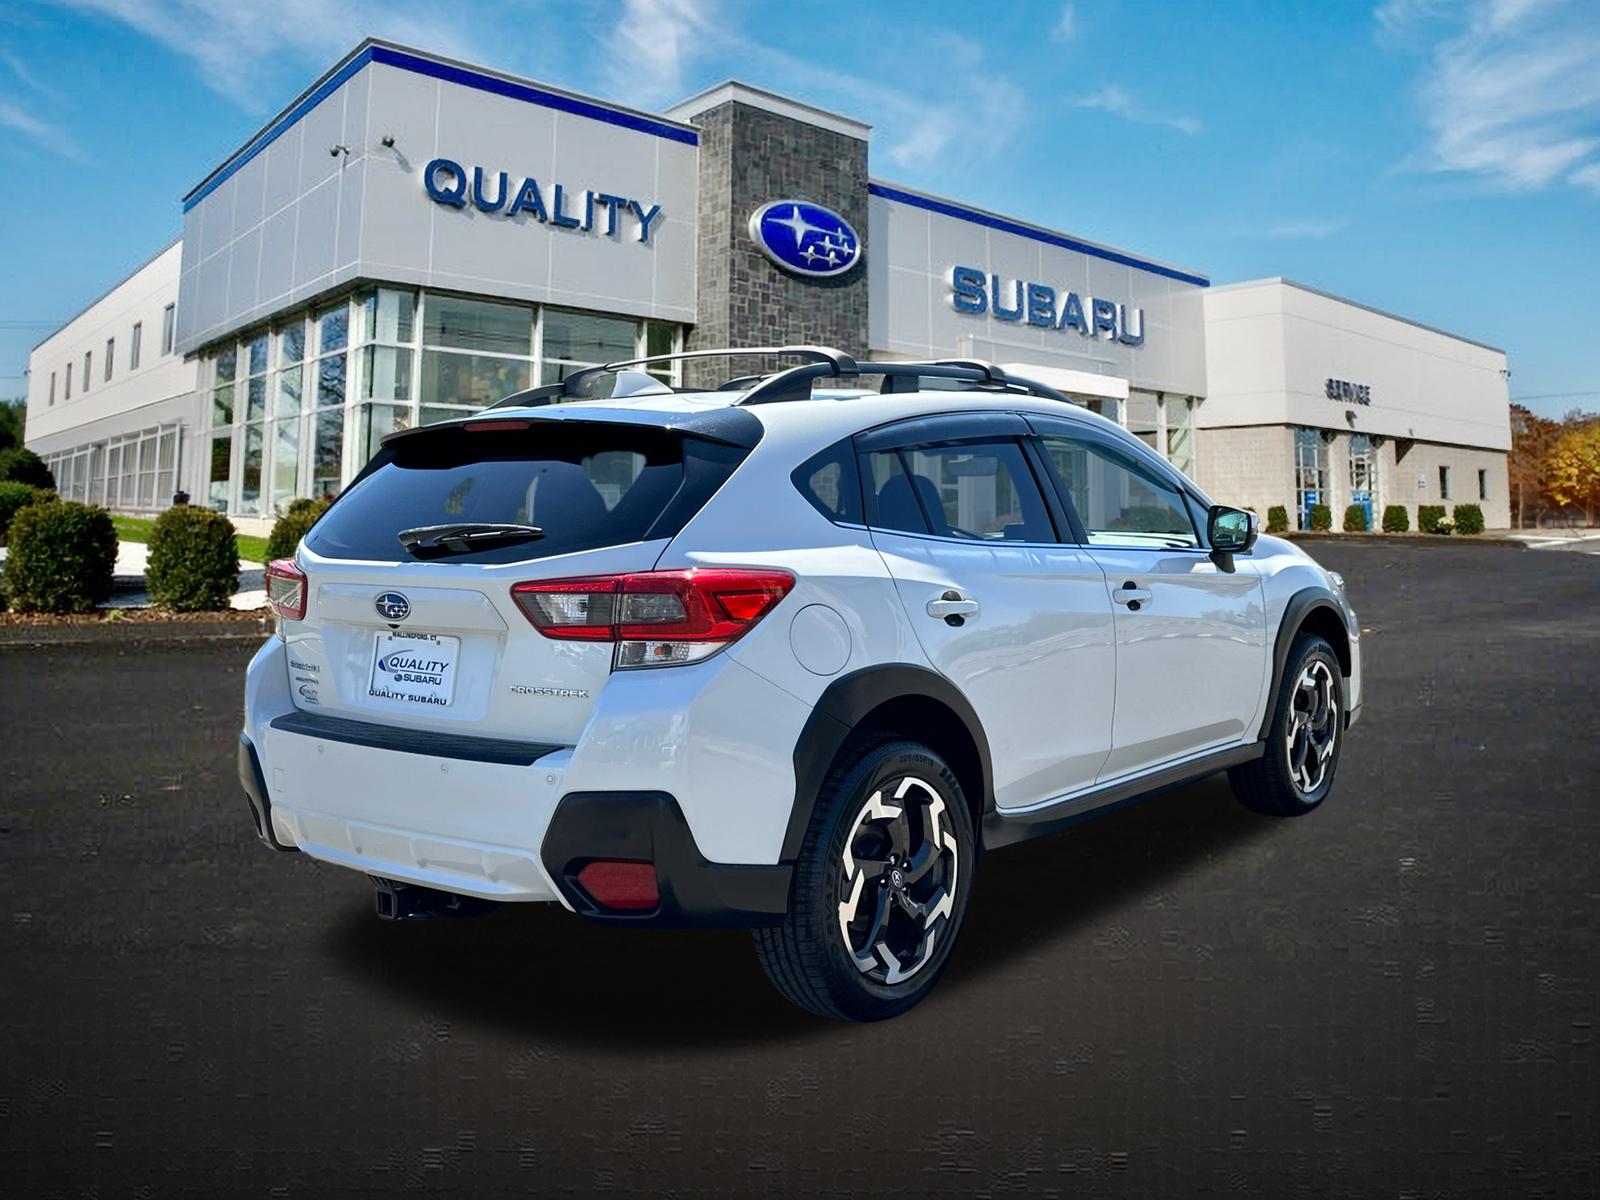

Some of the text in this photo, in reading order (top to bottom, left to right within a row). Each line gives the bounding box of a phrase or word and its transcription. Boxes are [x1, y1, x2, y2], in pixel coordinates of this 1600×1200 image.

[424, 158, 661, 243] QUALITY
[950, 265, 1144, 346] SUBARU
[430, 634, 437, 642] CT
[389, 657, 449, 673] QUALITY
[403, 673, 442, 686] SUBARU
[368, 689, 447, 706] QUALITY SUBARU
[510, 685, 590, 698] CROSSTREK
